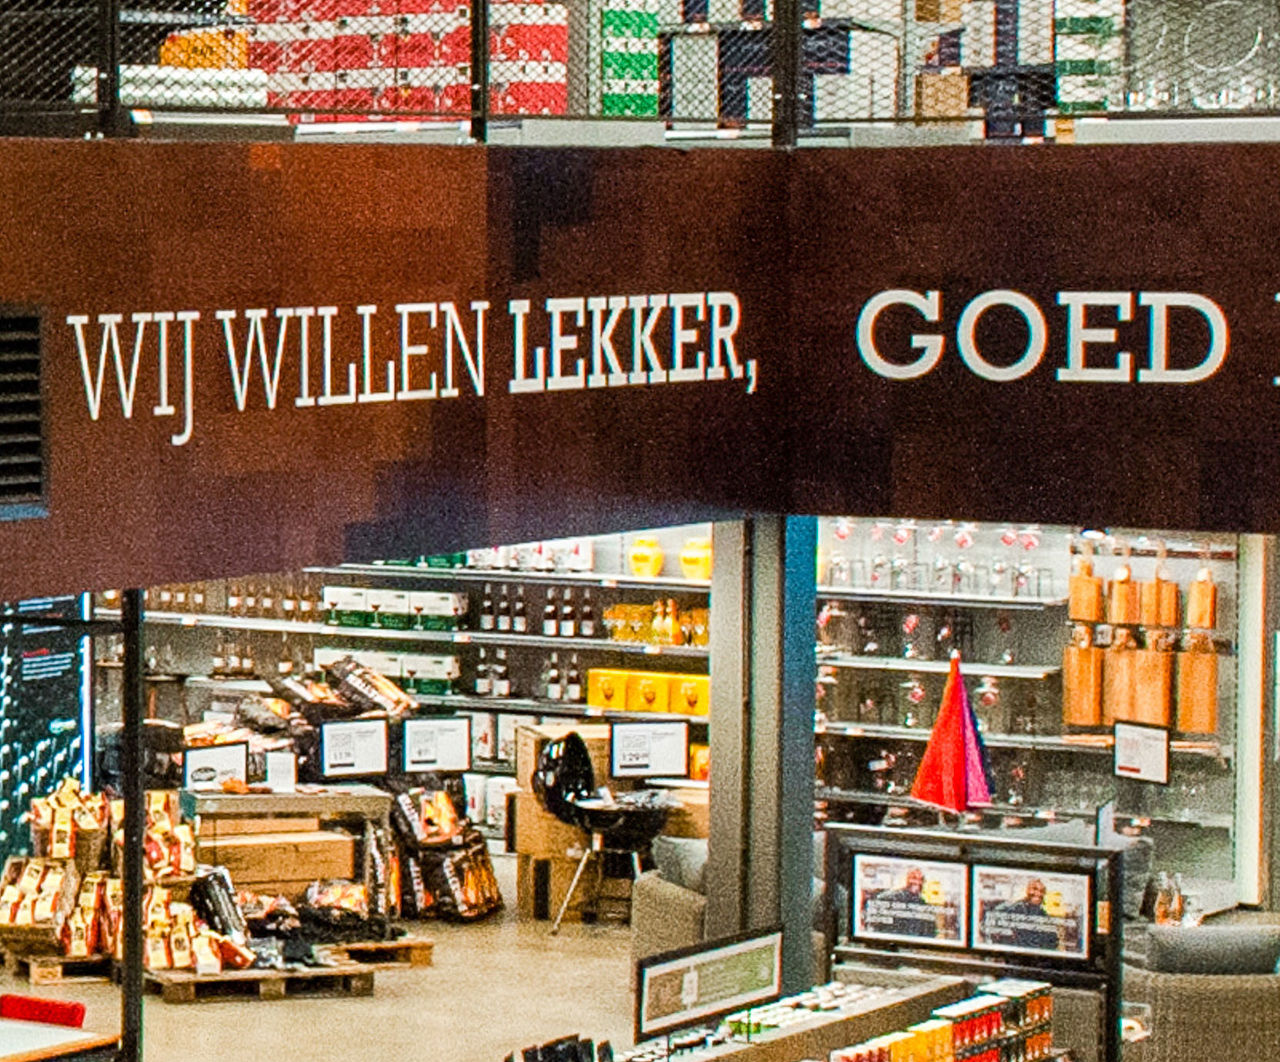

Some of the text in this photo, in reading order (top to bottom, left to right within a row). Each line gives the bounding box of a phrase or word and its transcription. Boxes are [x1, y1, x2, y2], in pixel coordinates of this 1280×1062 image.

[66, 310, 201, 446] WIJ
[214, 300, 490, 413] WILLEN
[508, 291, 758, 394] LEKKER,
[855, 288, 1230, 384] GOED
